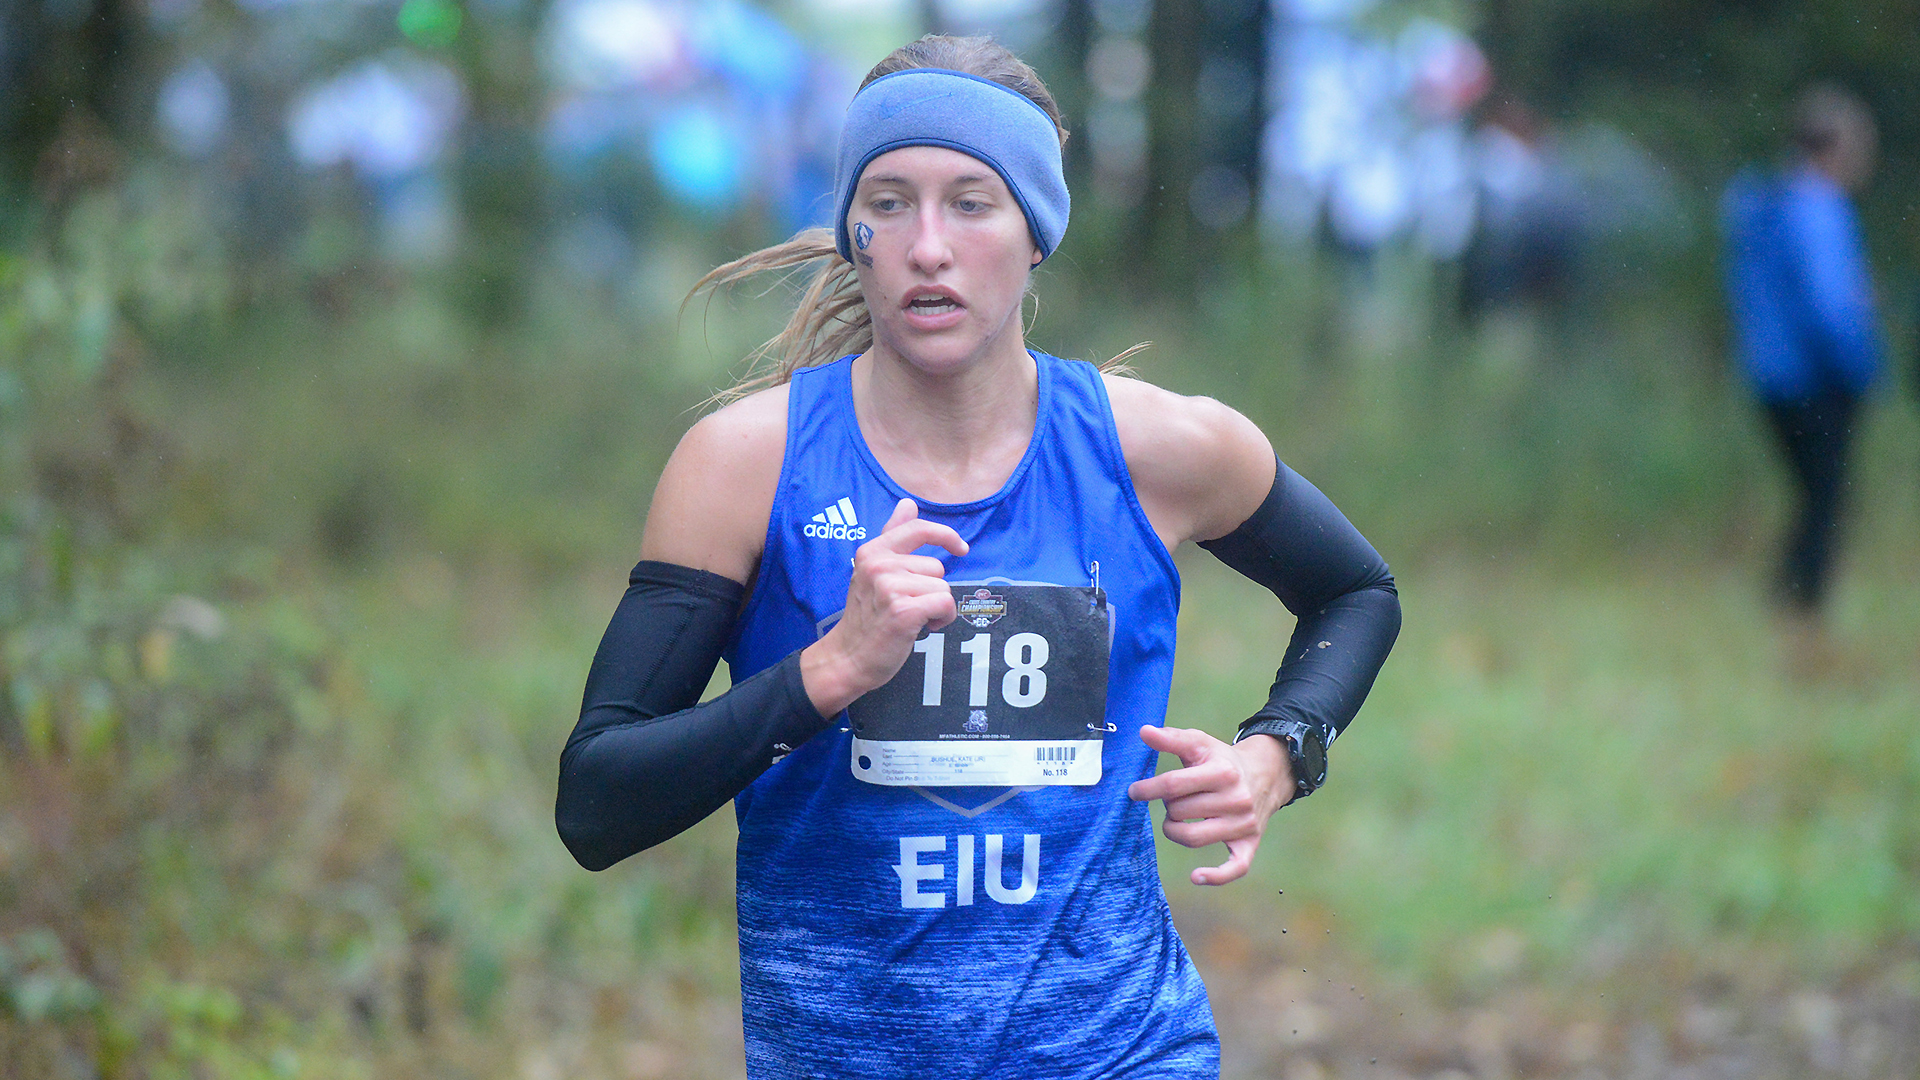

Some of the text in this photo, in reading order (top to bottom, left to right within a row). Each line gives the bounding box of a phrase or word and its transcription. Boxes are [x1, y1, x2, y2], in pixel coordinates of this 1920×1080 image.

[803, 522, 867, 541] adidas
[961, 604, 1003, 613] CHAMPIONSHIP
[914, 632, 1049, 708] 118
[891, 834, 1041, 909] EIU
